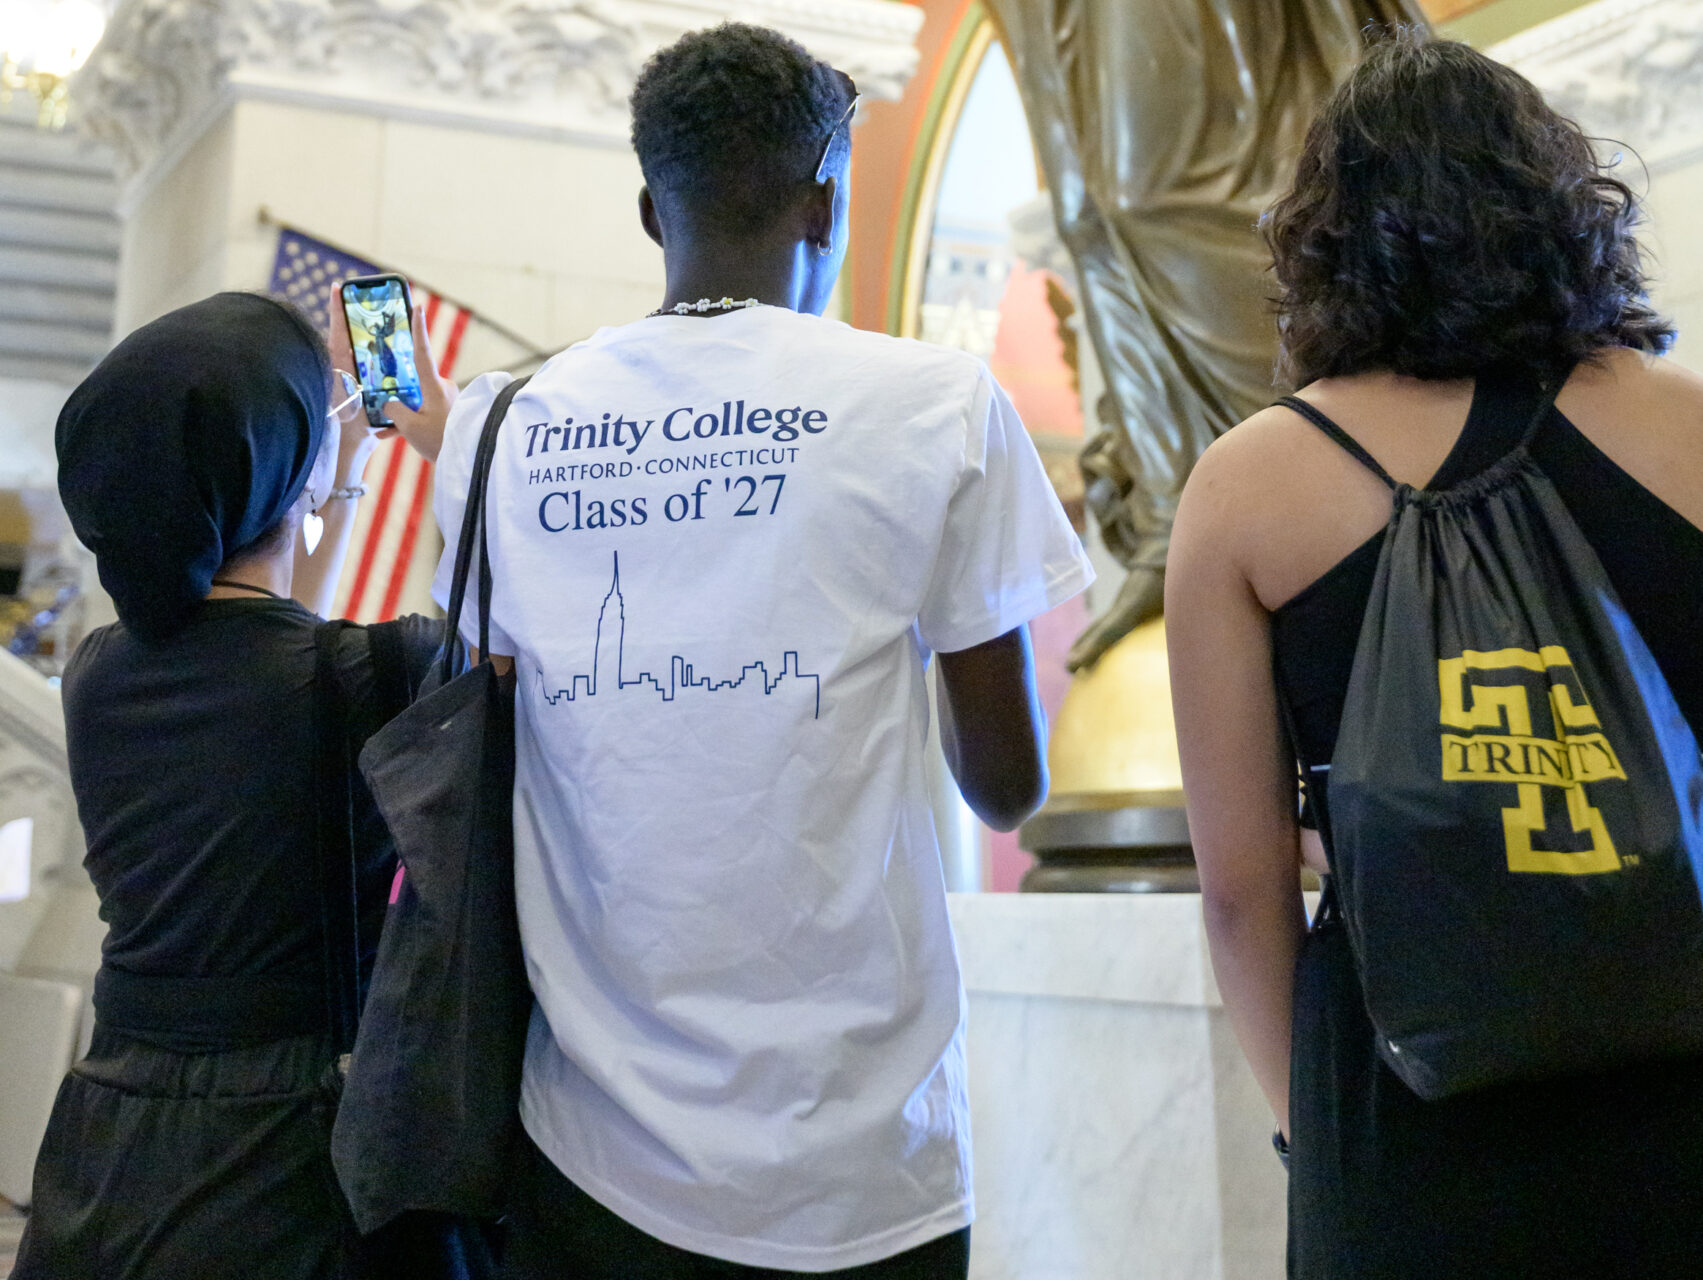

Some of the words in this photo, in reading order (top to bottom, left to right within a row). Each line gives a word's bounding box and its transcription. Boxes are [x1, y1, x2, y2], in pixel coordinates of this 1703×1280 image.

[526, 413, 655, 456] Trinity
[662, 400, 828, 442] College
[538, 489, 648, 533] Class
[664, 478, 712, 522] of
[724, 474, 786, 517] '27
[1449, 739, 1618, 779] TRINITY
